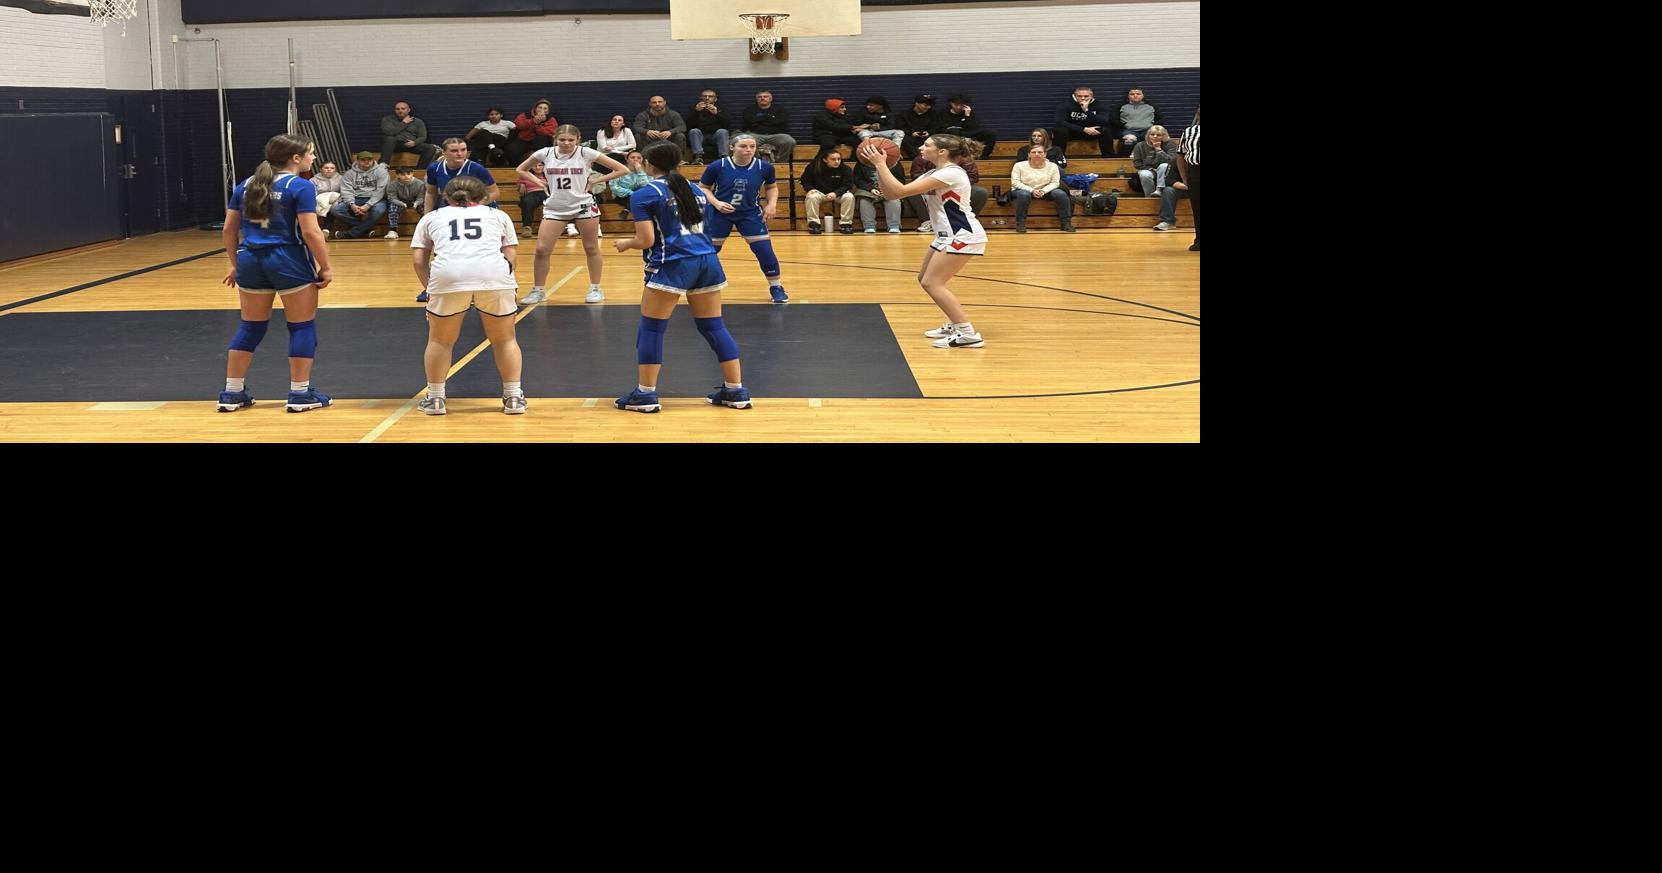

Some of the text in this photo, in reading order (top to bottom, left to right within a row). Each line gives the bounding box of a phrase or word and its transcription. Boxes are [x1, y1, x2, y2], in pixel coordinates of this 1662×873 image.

[556, 177, 572, 190] 12
[730, 193, 743, 205] 2
[448, 218, 482, 241] 15
